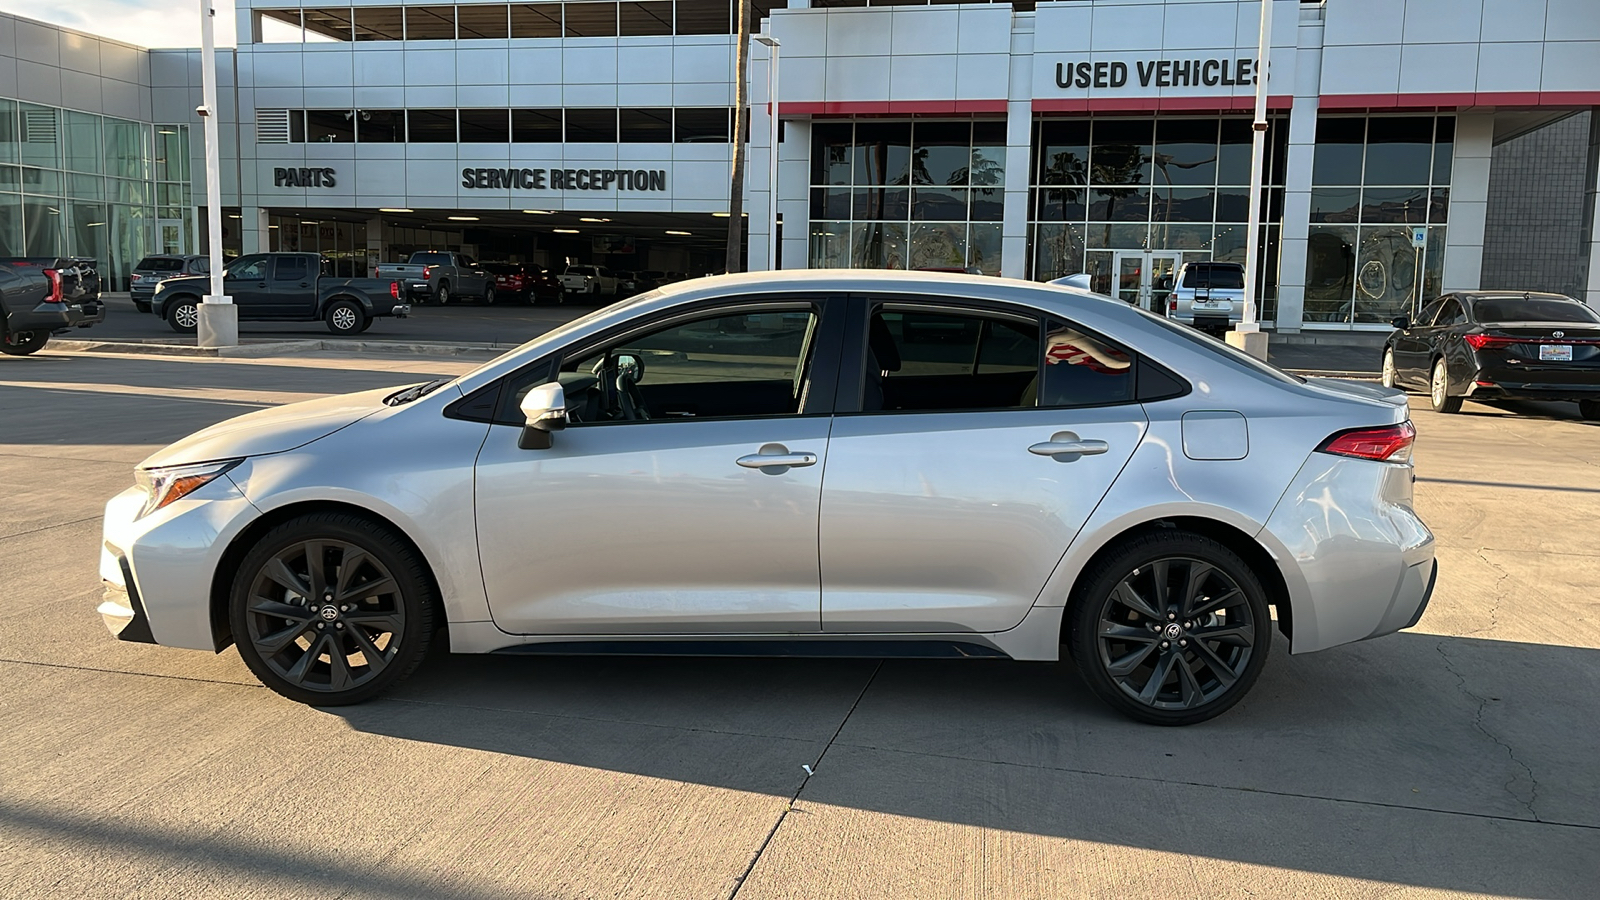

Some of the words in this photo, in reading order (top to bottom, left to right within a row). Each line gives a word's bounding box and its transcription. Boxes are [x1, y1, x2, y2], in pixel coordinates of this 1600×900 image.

[1055, 62, 1128, 89] USED
[273, 167, 337, 189] PARTS
[461, 168, 547, 190] SERVICE
[550, 168, 667, 192] RECEPTION
[281, 224, 308, 234] ESET
